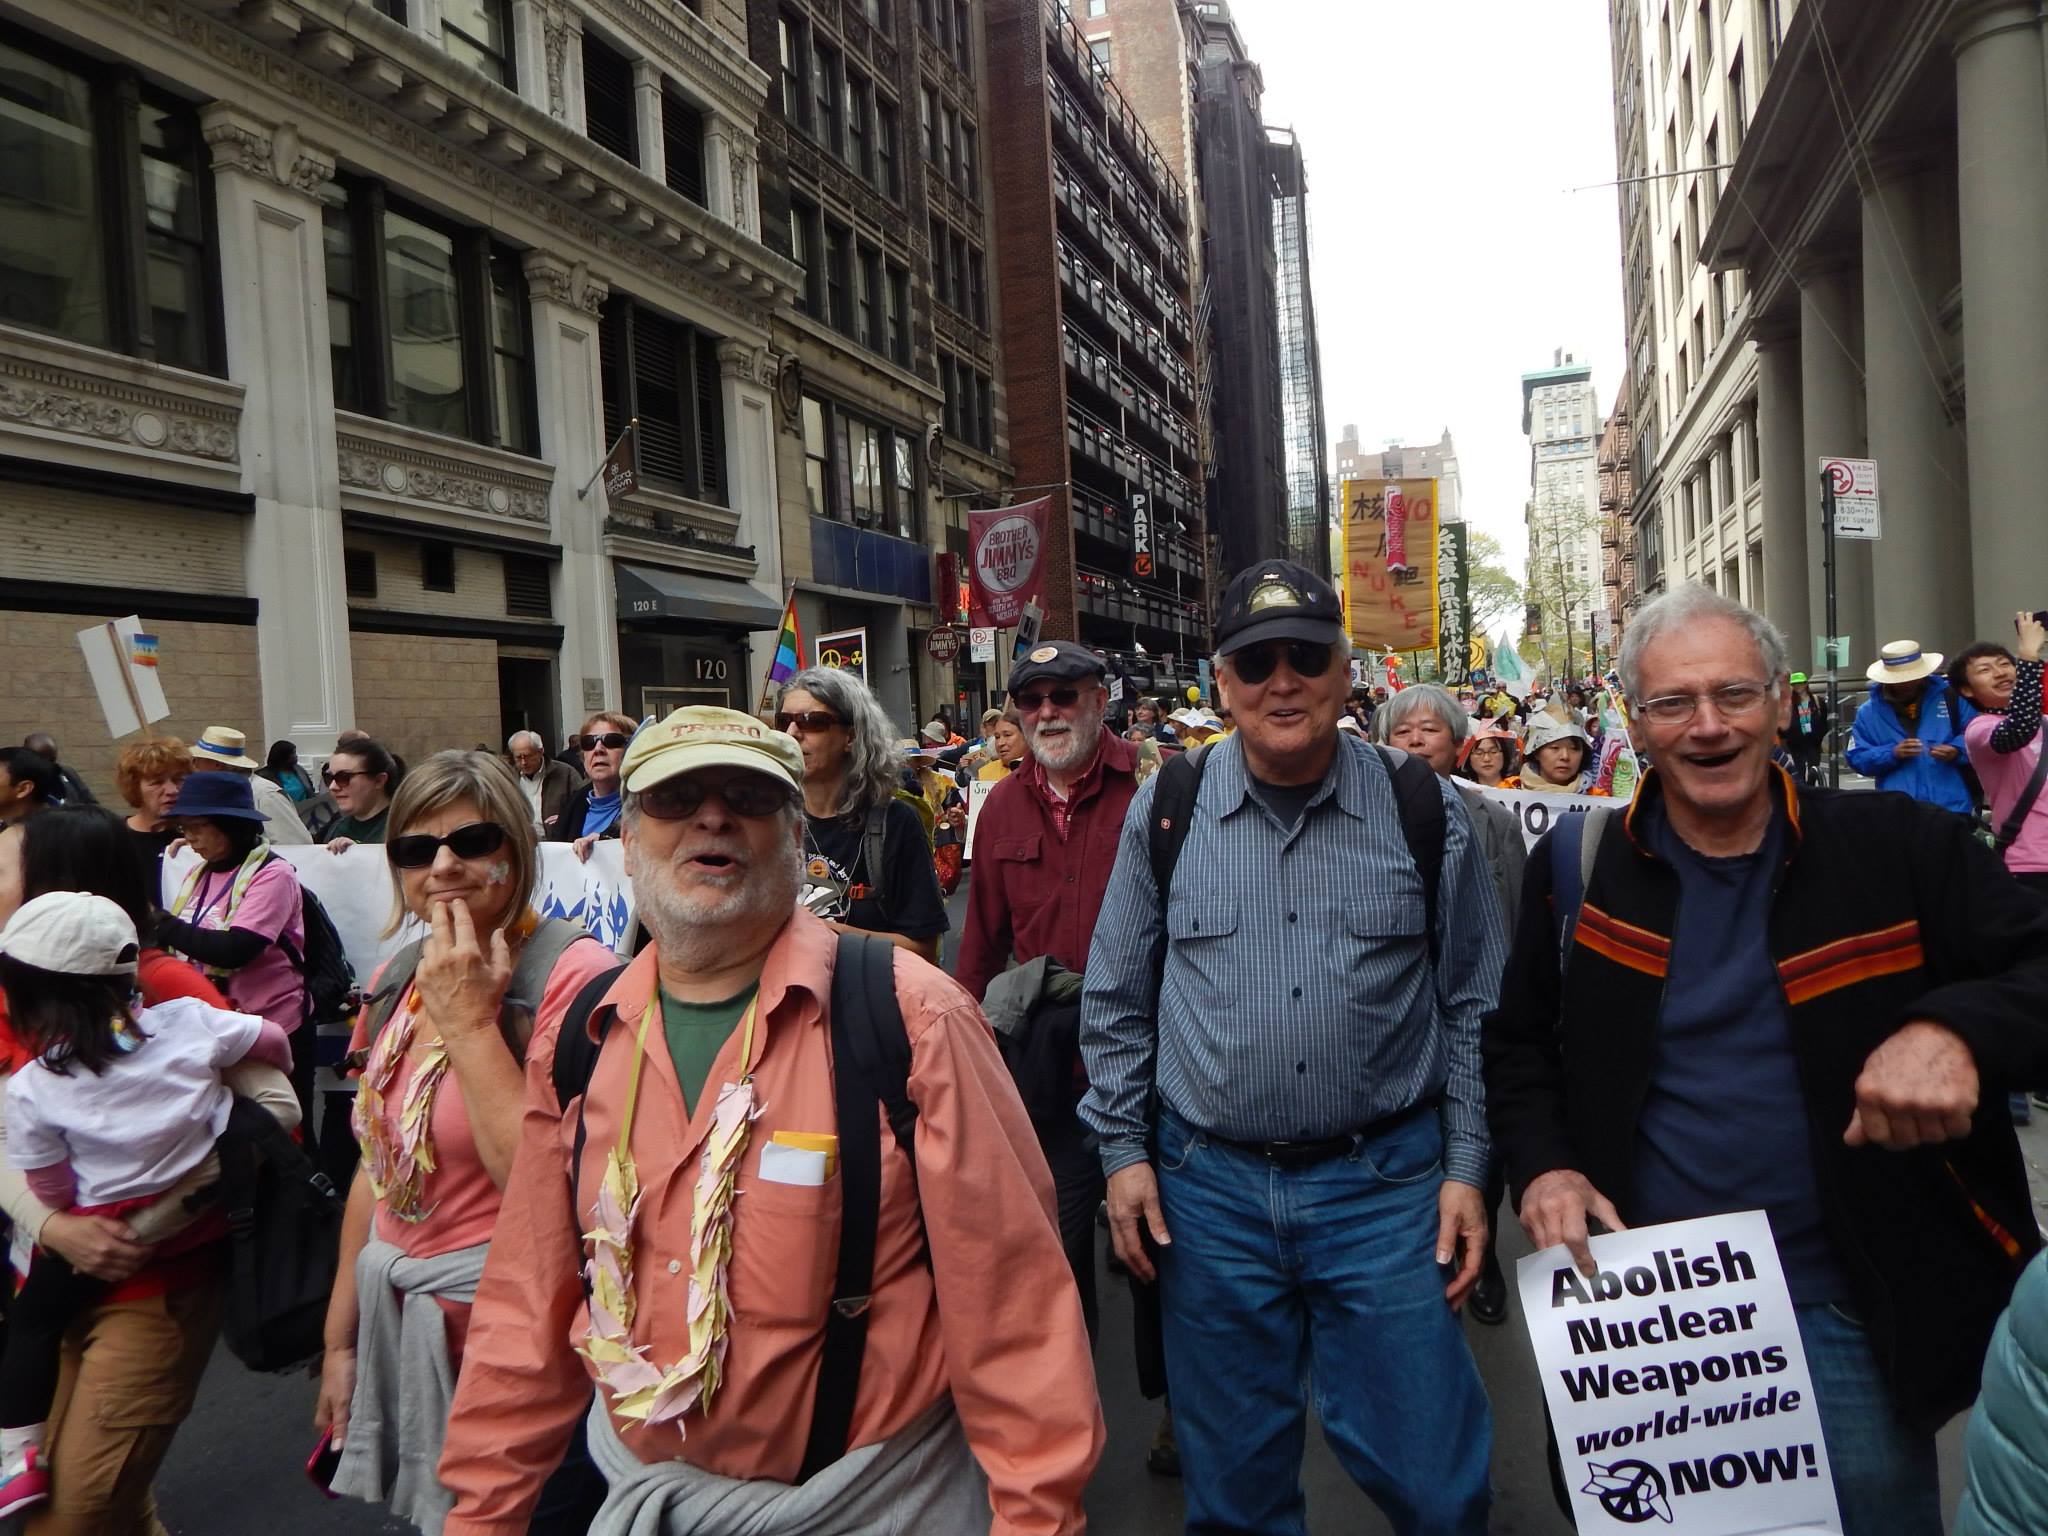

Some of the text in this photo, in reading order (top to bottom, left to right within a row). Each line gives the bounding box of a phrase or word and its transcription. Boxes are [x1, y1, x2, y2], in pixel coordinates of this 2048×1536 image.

[989, 526, 1028, 546] BROTHER
[1132, 494, 1150, 553] PARK
[997, 566, 1017, 581] BBQ
[633, 600, 658, 612] 120 E
[696, 658, 727, 680] 120
[1551, 1240, 1757, 1308] Abolish
[1566, 1302, 1758, 1355] Nuclear
[1560, 1345, 1789, 1402] Weapons
[1576, 1386, 1802, 1456] world-wide
[1668, 1443, 1820, 1496] NOW!
